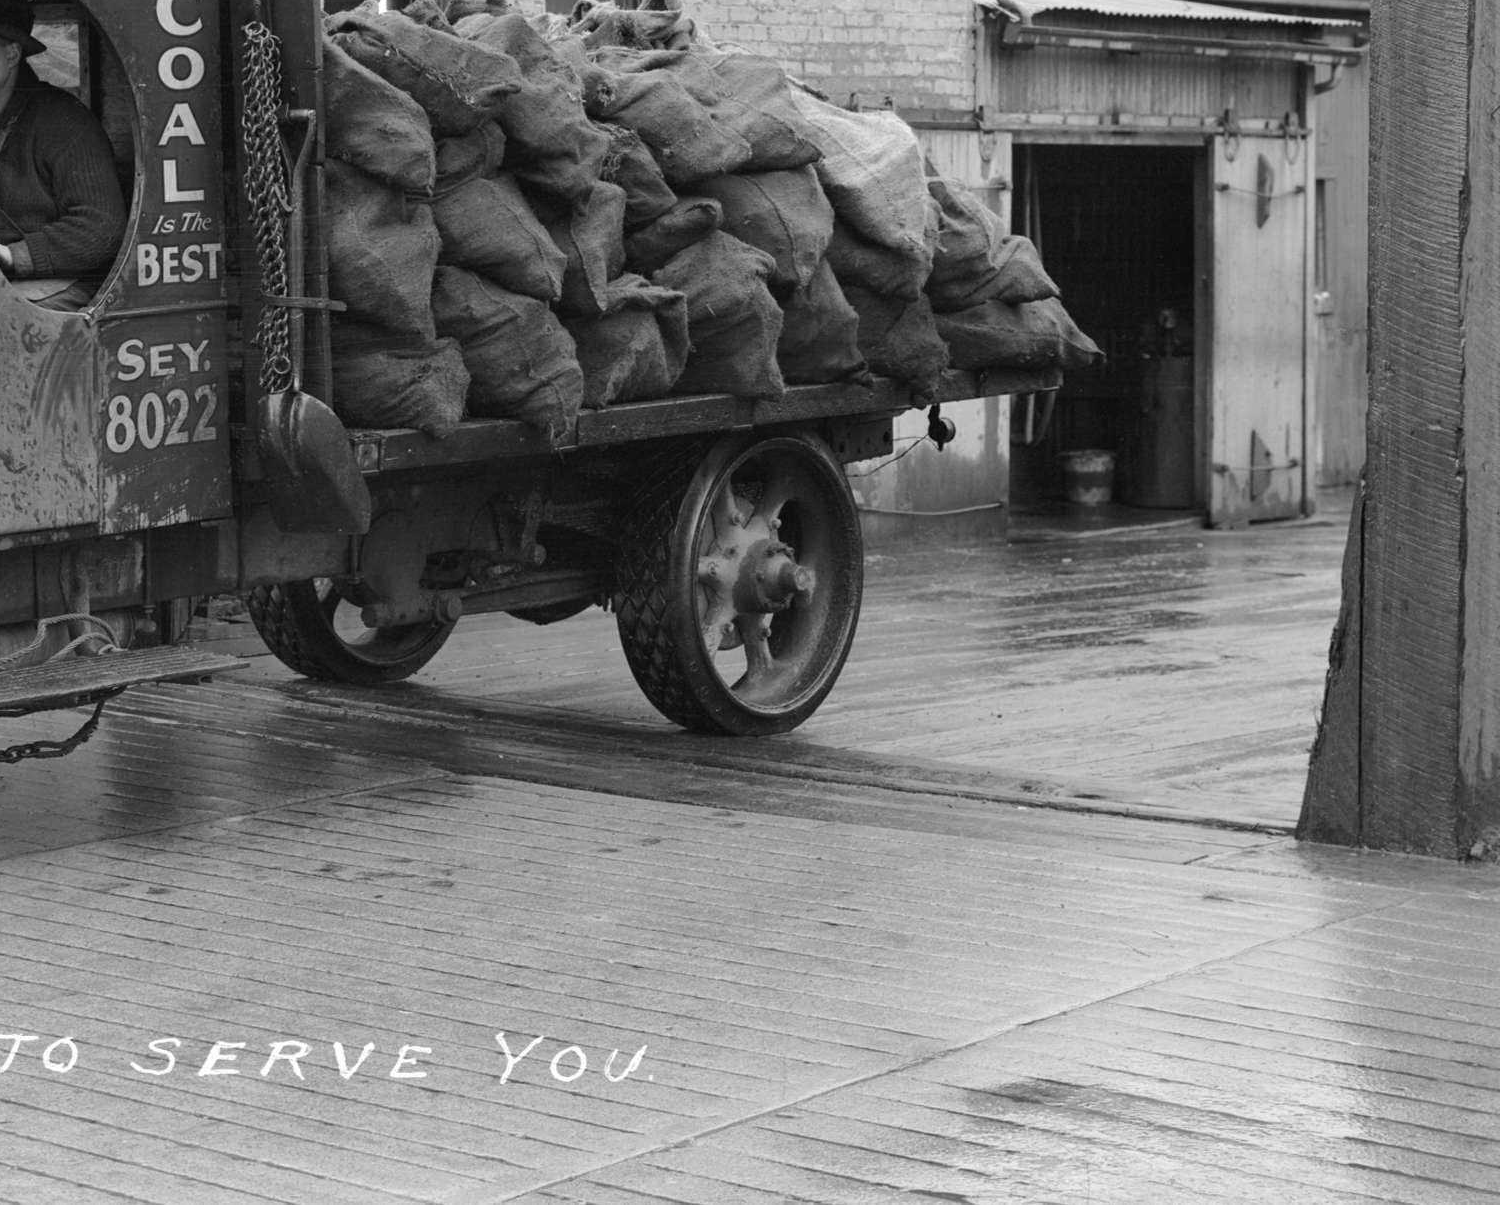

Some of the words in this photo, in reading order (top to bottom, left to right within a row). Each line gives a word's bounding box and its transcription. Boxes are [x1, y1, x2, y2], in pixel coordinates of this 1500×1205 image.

[181, 211, 212, 233] The
[137, 242, 223, 287] BEST
[116, 338, 210, 382] SEY.
[105, 382, 218, 454] 8022
